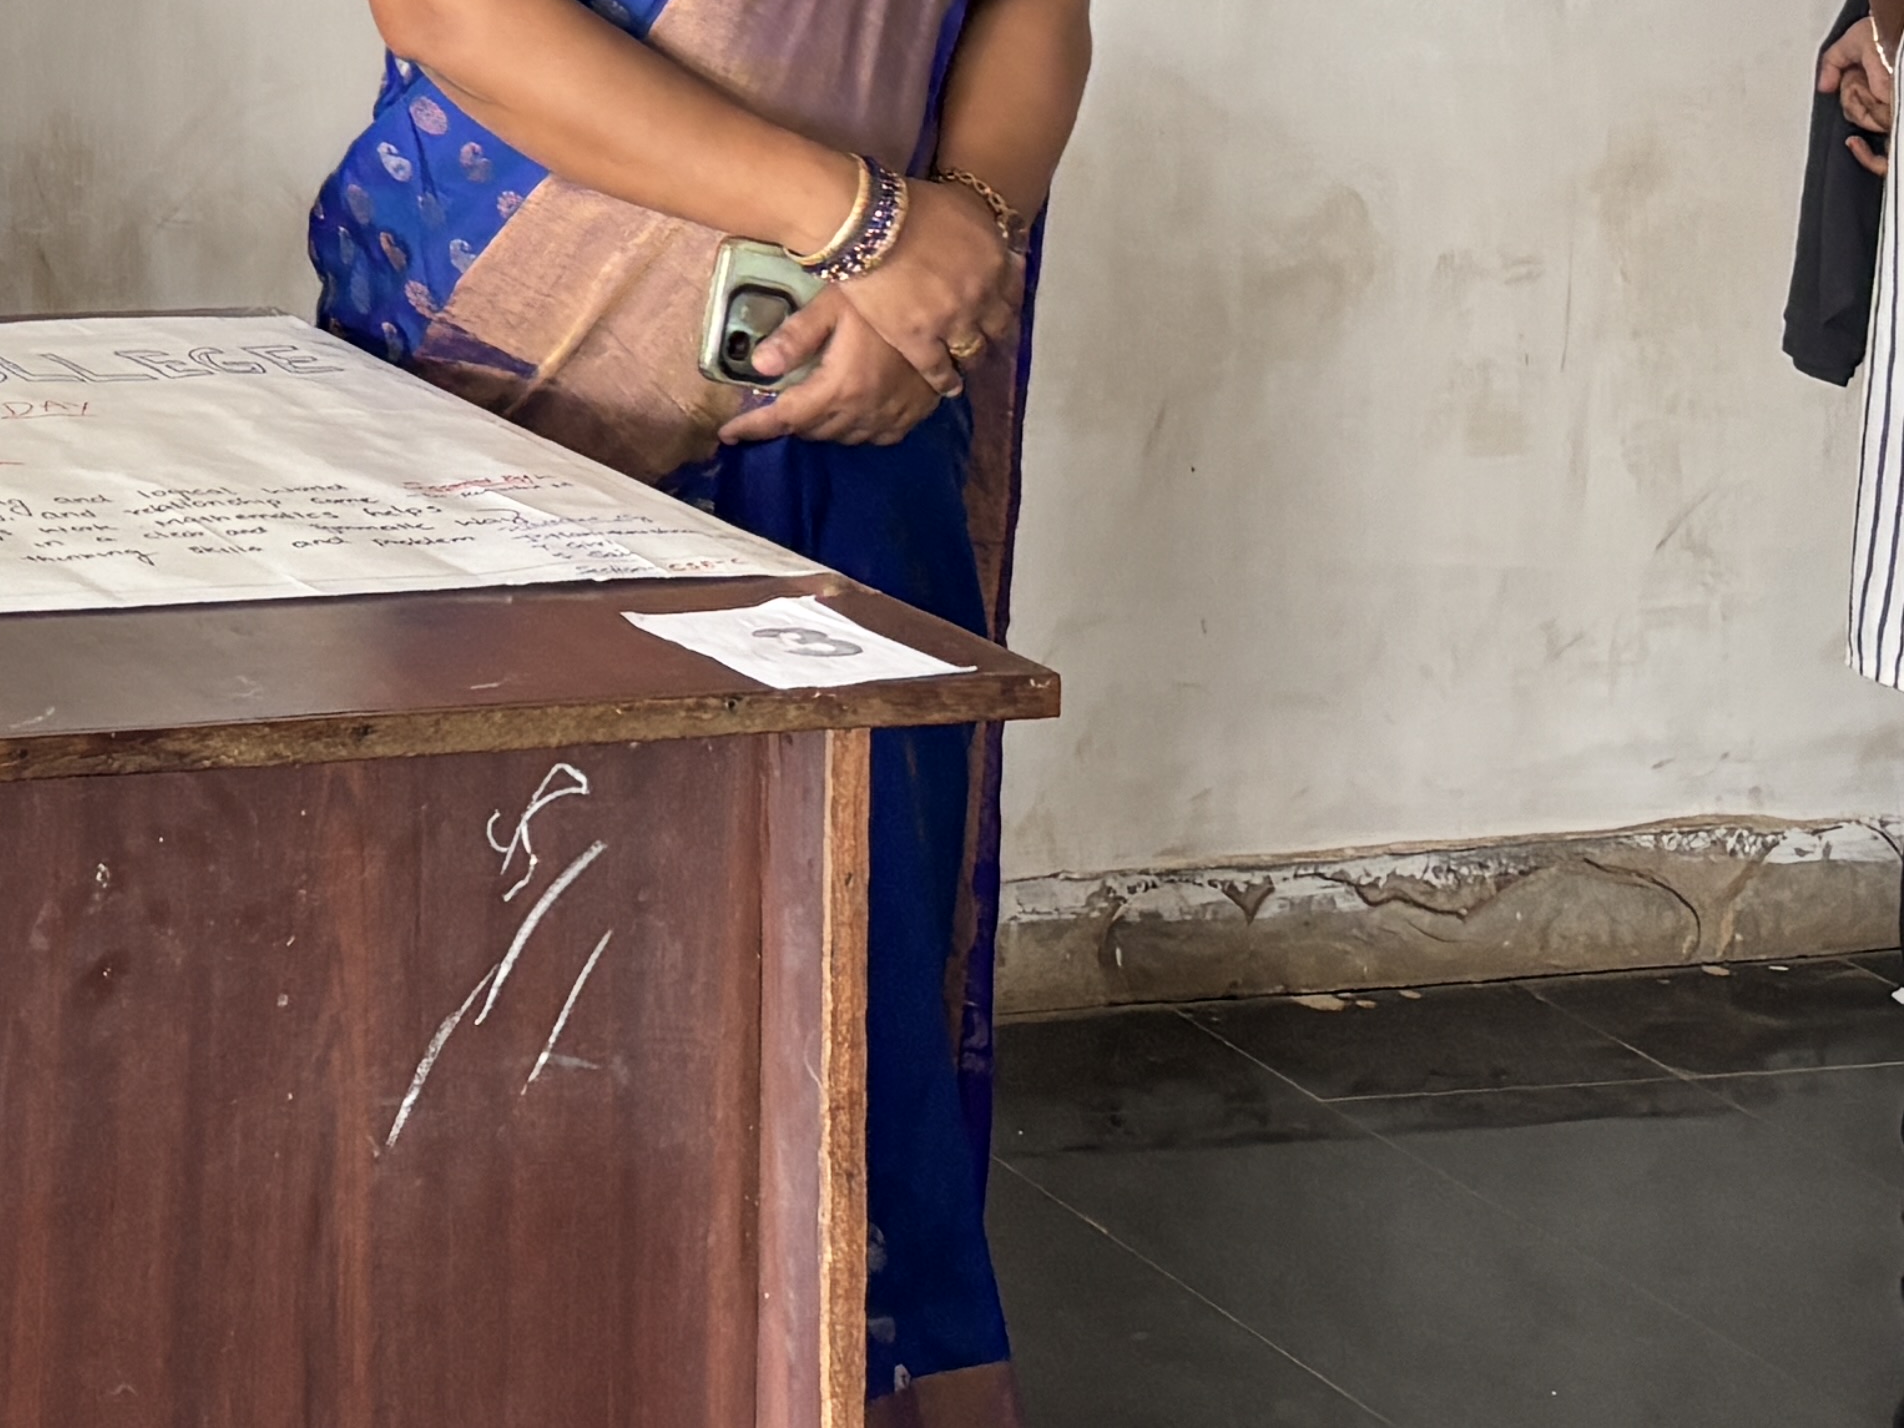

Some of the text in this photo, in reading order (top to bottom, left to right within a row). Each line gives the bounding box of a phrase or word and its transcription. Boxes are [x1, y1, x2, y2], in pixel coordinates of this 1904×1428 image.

[2, 400, 90, 419] DAY
[54, 494, 113, 505] and
[40, 509, 97, 521] and
[362, 505, 443, 519] helps
[291, 536, 352, 549] and
[752, 626, 864, 658] 3
